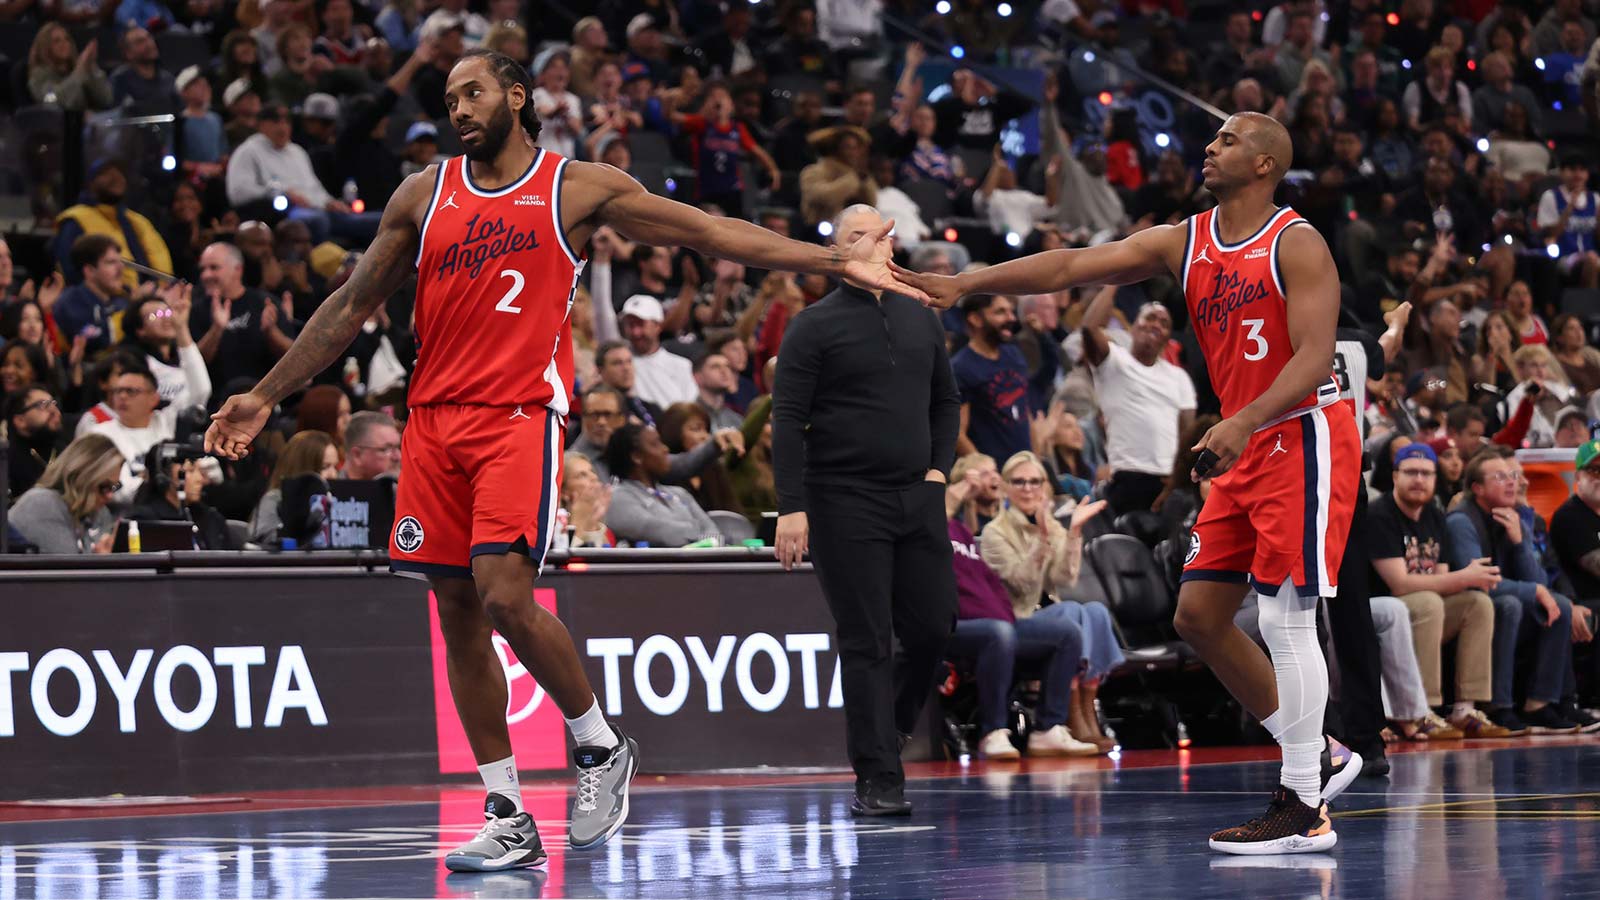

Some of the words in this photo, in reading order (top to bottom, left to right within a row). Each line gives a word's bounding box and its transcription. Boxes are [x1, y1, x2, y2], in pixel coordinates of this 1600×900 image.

[438, 225, 540, 281] Angeles
[462, 213, 506, 246] Los
[495, 269, 525, 314] 2
[1197, 278, 1270, 333] Angeles
[1211, 266, 1240, 300] Los
[1241, 318, 1269, 361] 3
[0, 645, 328, 737] TOYOTA
[586, 632, 844, 716] TOYOT
